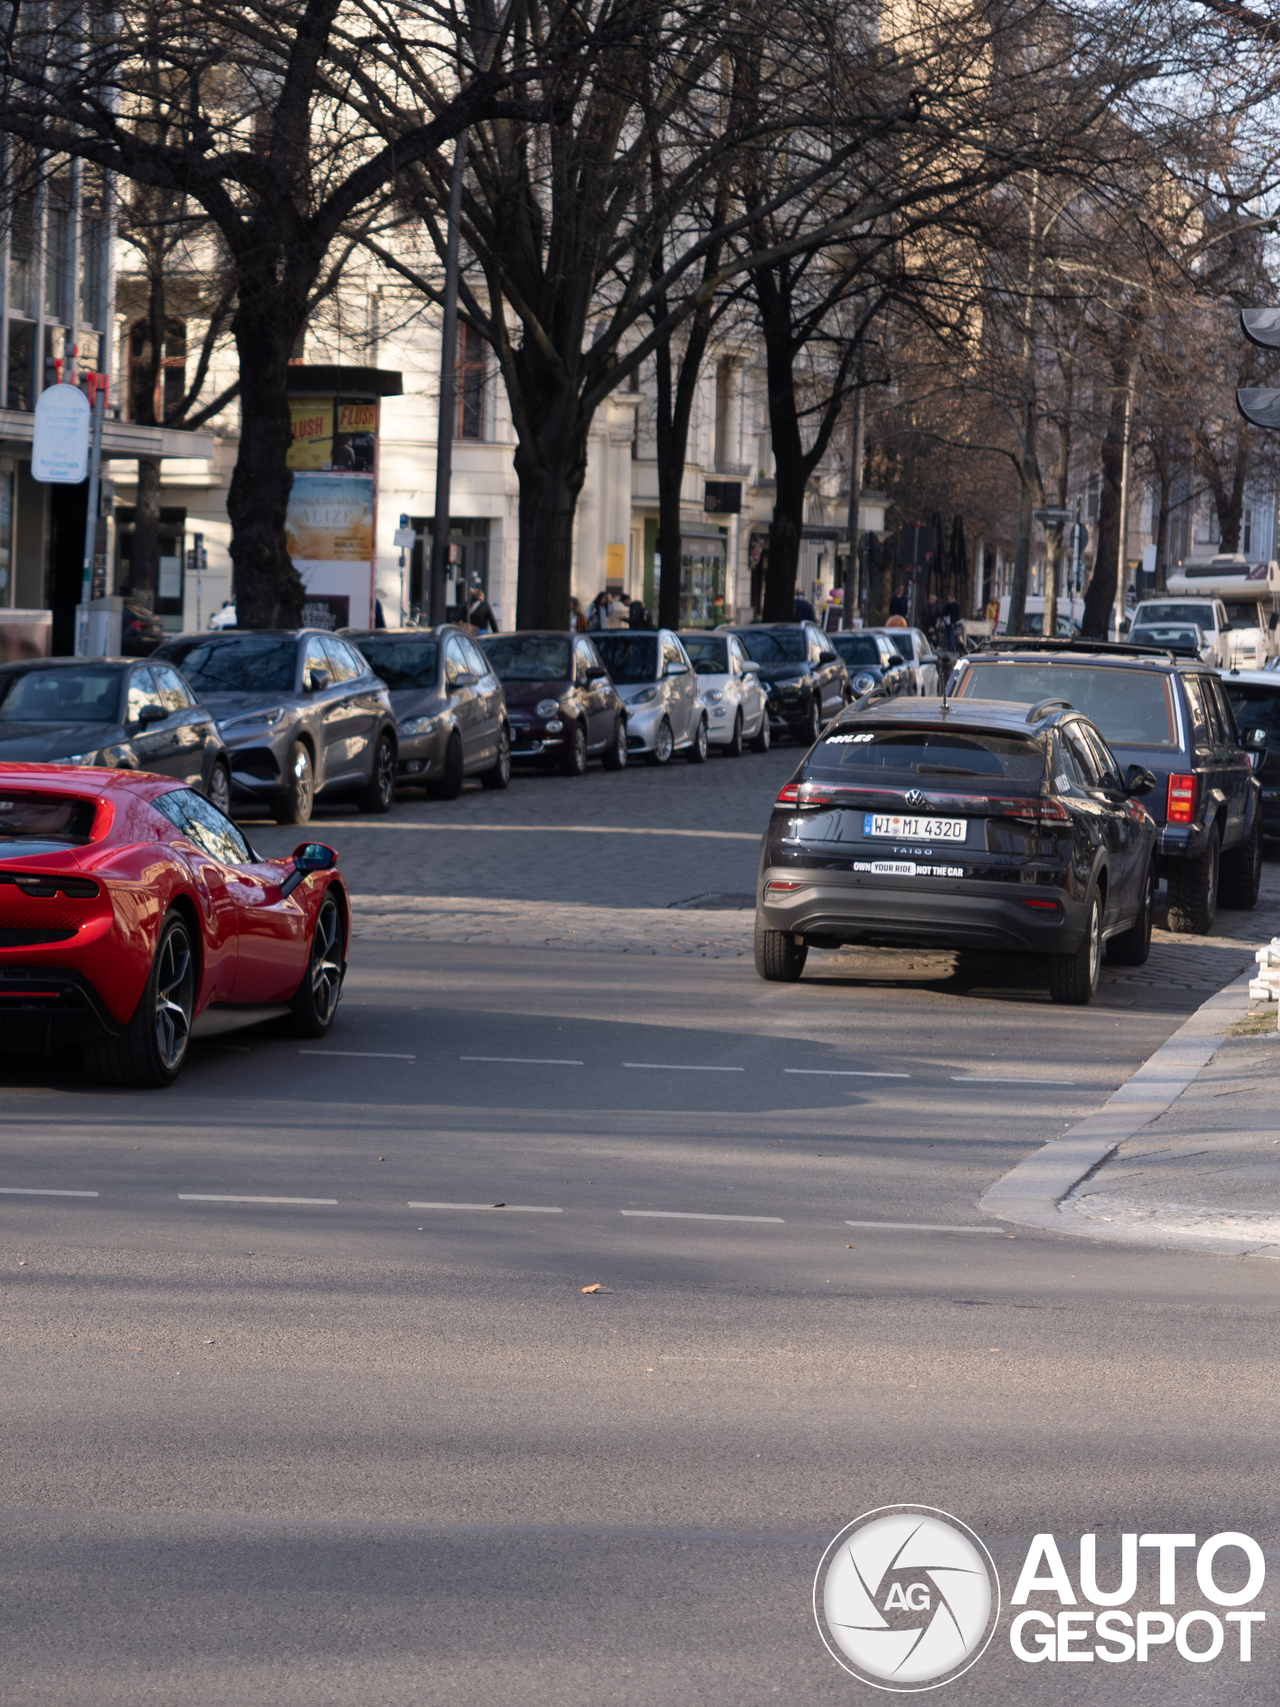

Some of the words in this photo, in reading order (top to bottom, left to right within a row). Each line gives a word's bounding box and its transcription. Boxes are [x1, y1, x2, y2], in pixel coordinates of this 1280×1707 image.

[340, 405, 375, 426] FLUSH
[826, 734, 874, 744] MILES
[875, 818, 890, 834] WI
[903, 819, 919, 835] MI
[925, 820, 961, 838] 4320
[892, 847, 933, 855] TAIGO
[853, 862, 871, 872] OWN
[874, 864, 894, 872] YOUR
[895, 864, 912, 873] RIDE
[916, 866, 932, 875] NOT
[932, 867, 947, 876] THE
[947, 868, 963, 877] CAR
